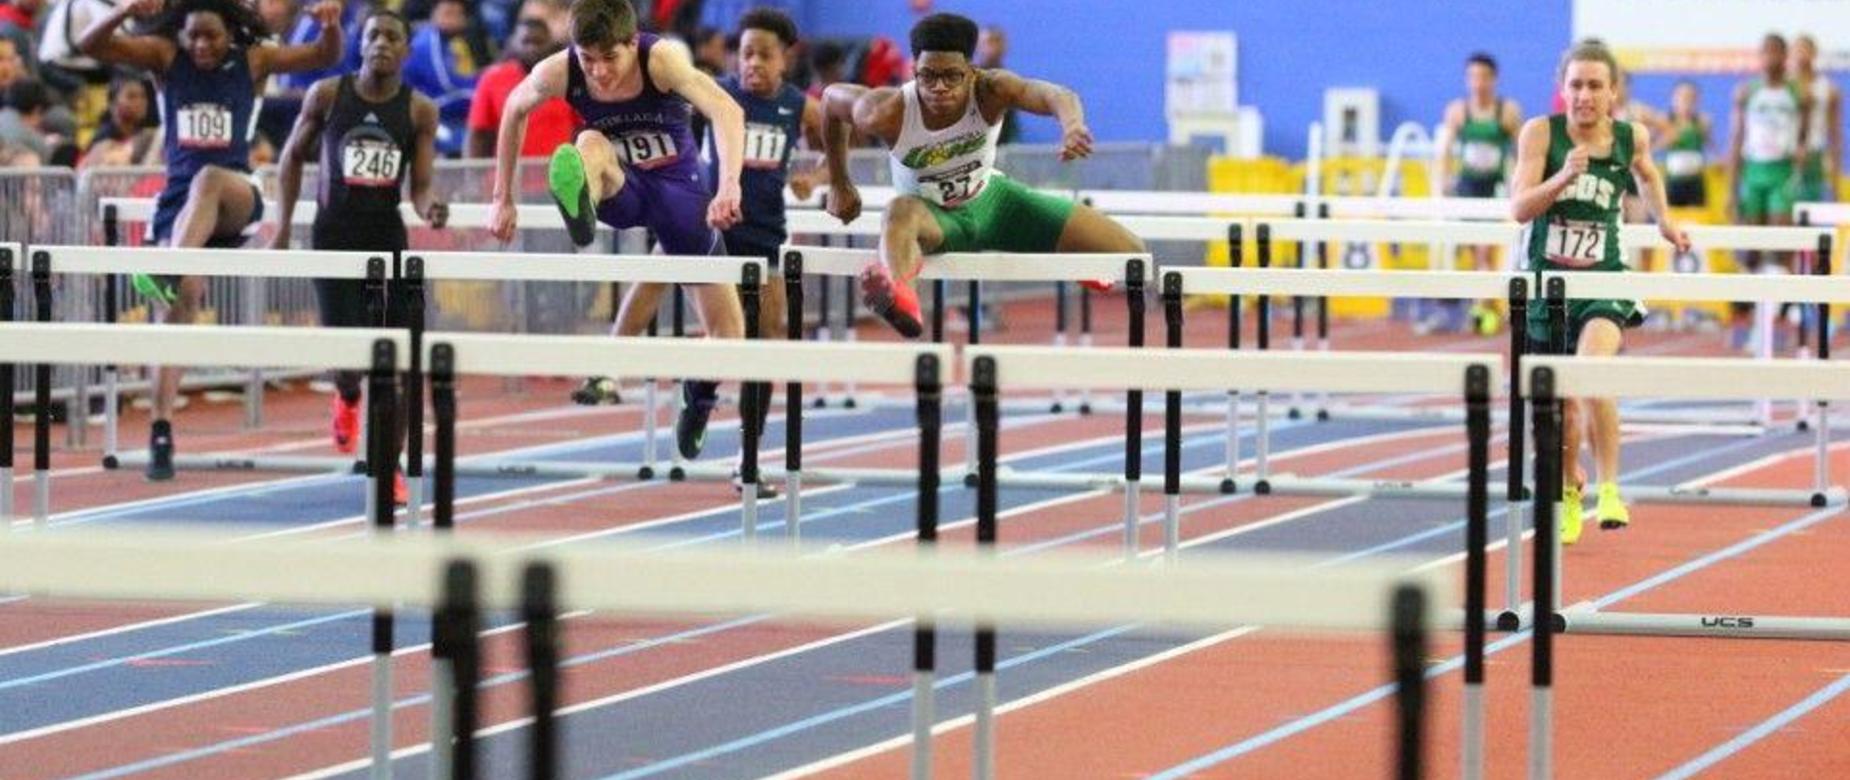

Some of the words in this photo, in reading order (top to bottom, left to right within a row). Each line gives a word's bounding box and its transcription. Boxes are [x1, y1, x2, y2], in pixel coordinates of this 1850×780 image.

[188, 112, 225, 138] 109
[352, 148, 394, 177] 246
[939, 176, 971, 202] 27
[1560, 229, 1599, 259] 172
[1701, 616, 1754, 628] UCS
